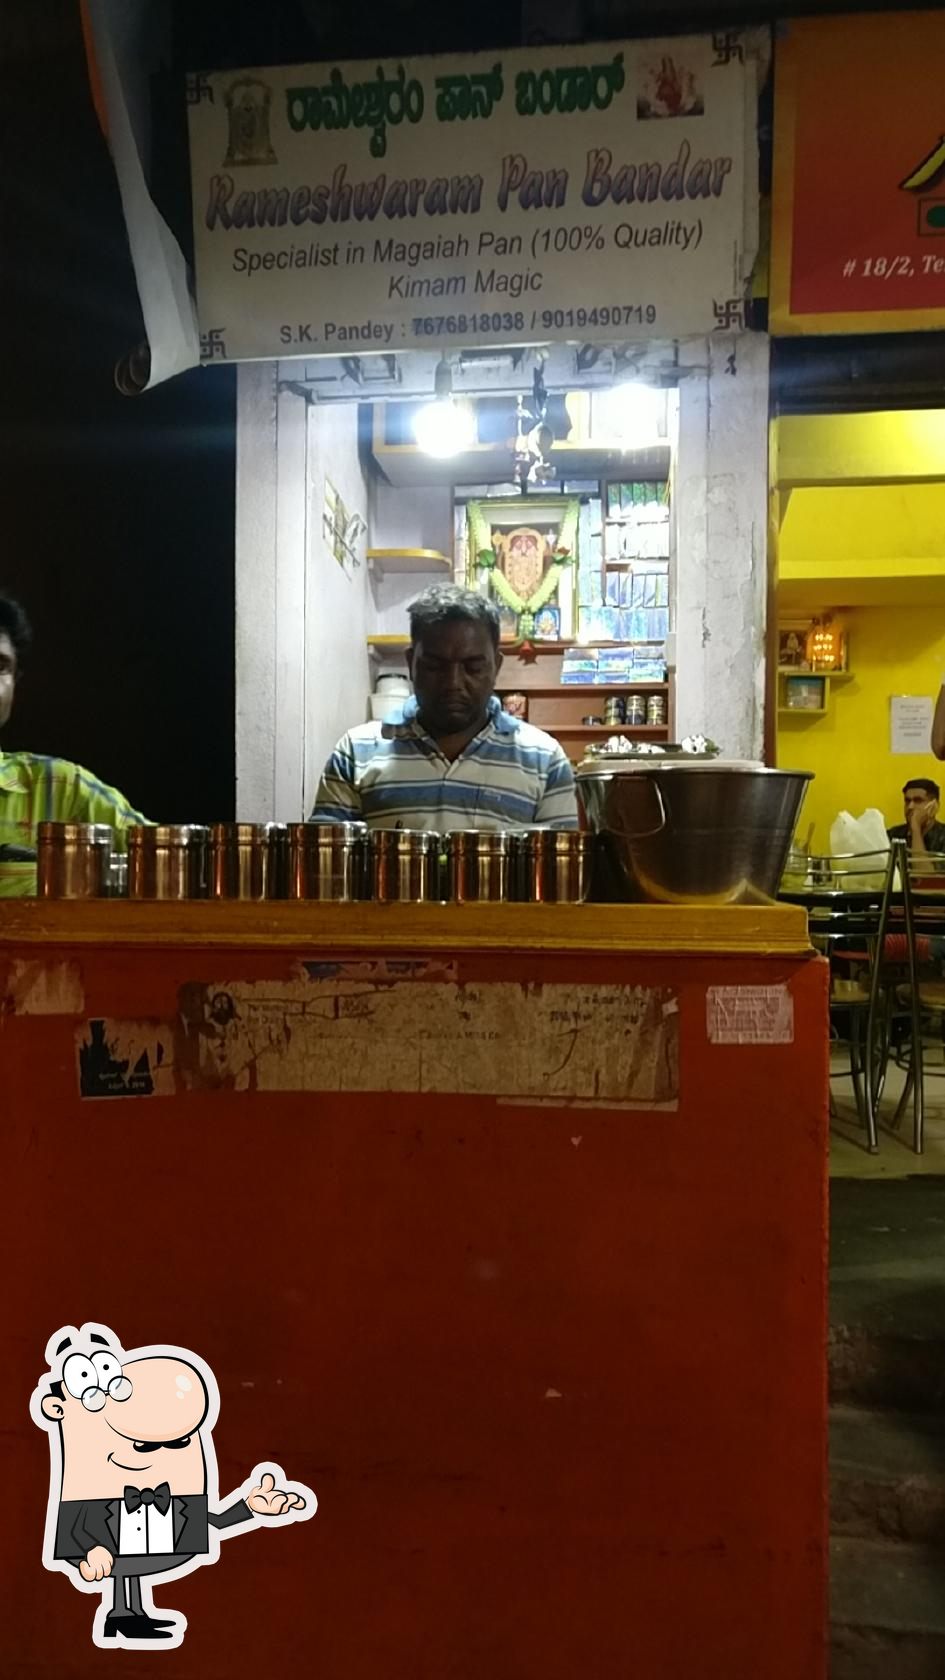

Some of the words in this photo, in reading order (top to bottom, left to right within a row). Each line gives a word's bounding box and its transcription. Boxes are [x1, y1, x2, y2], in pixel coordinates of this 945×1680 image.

[434, 61, 504, 122] ಪಾನ್
[205, 163, 483, 231] Rameshwaram
[497, 153, 569, 213] Pan
[581, 138, 733, 207] Bandar
[232, 244, 339, 276] Specialist
[346, 240, 365, 264] in
[373, 233, 469, 267] Magaiah
[478, 231, 522, 256] Pan
[531, 223, 605, 258] (100%
[614, 219, 703, 249] Quality)
[843, 259, 856, 278] #
[861, 255, 915, 280] 18/2,
[922, 254, 945, 274] Te
[388, 274, 466, 299] Kimam
[474, 267, 543, 298] Magic
[280, 324, 318, 343] S.K.
[324, 320, 394, 342] Pandey
[412, 311, 524, 337] 7676818038
[542, 304, 657, 328] 9019490719
